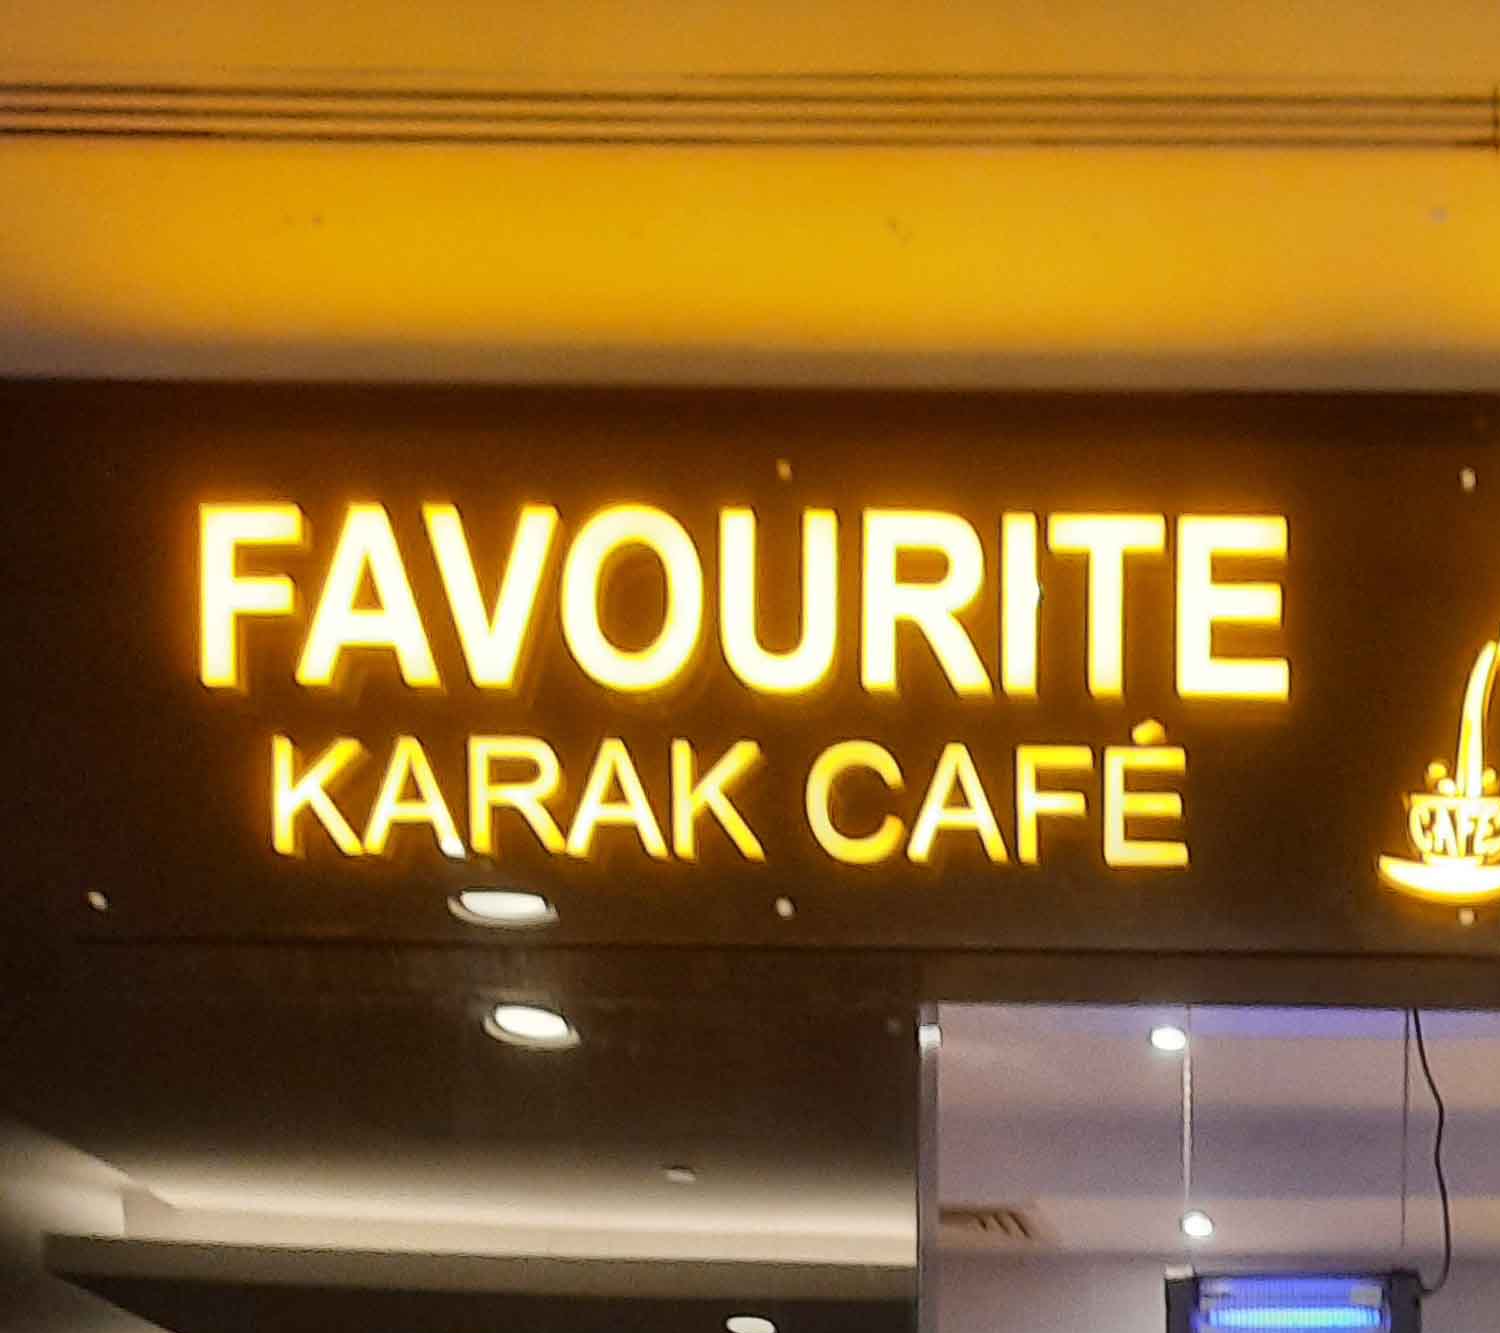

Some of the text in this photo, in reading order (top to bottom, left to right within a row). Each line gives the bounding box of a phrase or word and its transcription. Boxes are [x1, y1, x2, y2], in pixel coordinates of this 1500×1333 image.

[196, 499, 1292, 701] FAVOURITE
[268, 718, 1192, 869] KARAK CAFÉ
